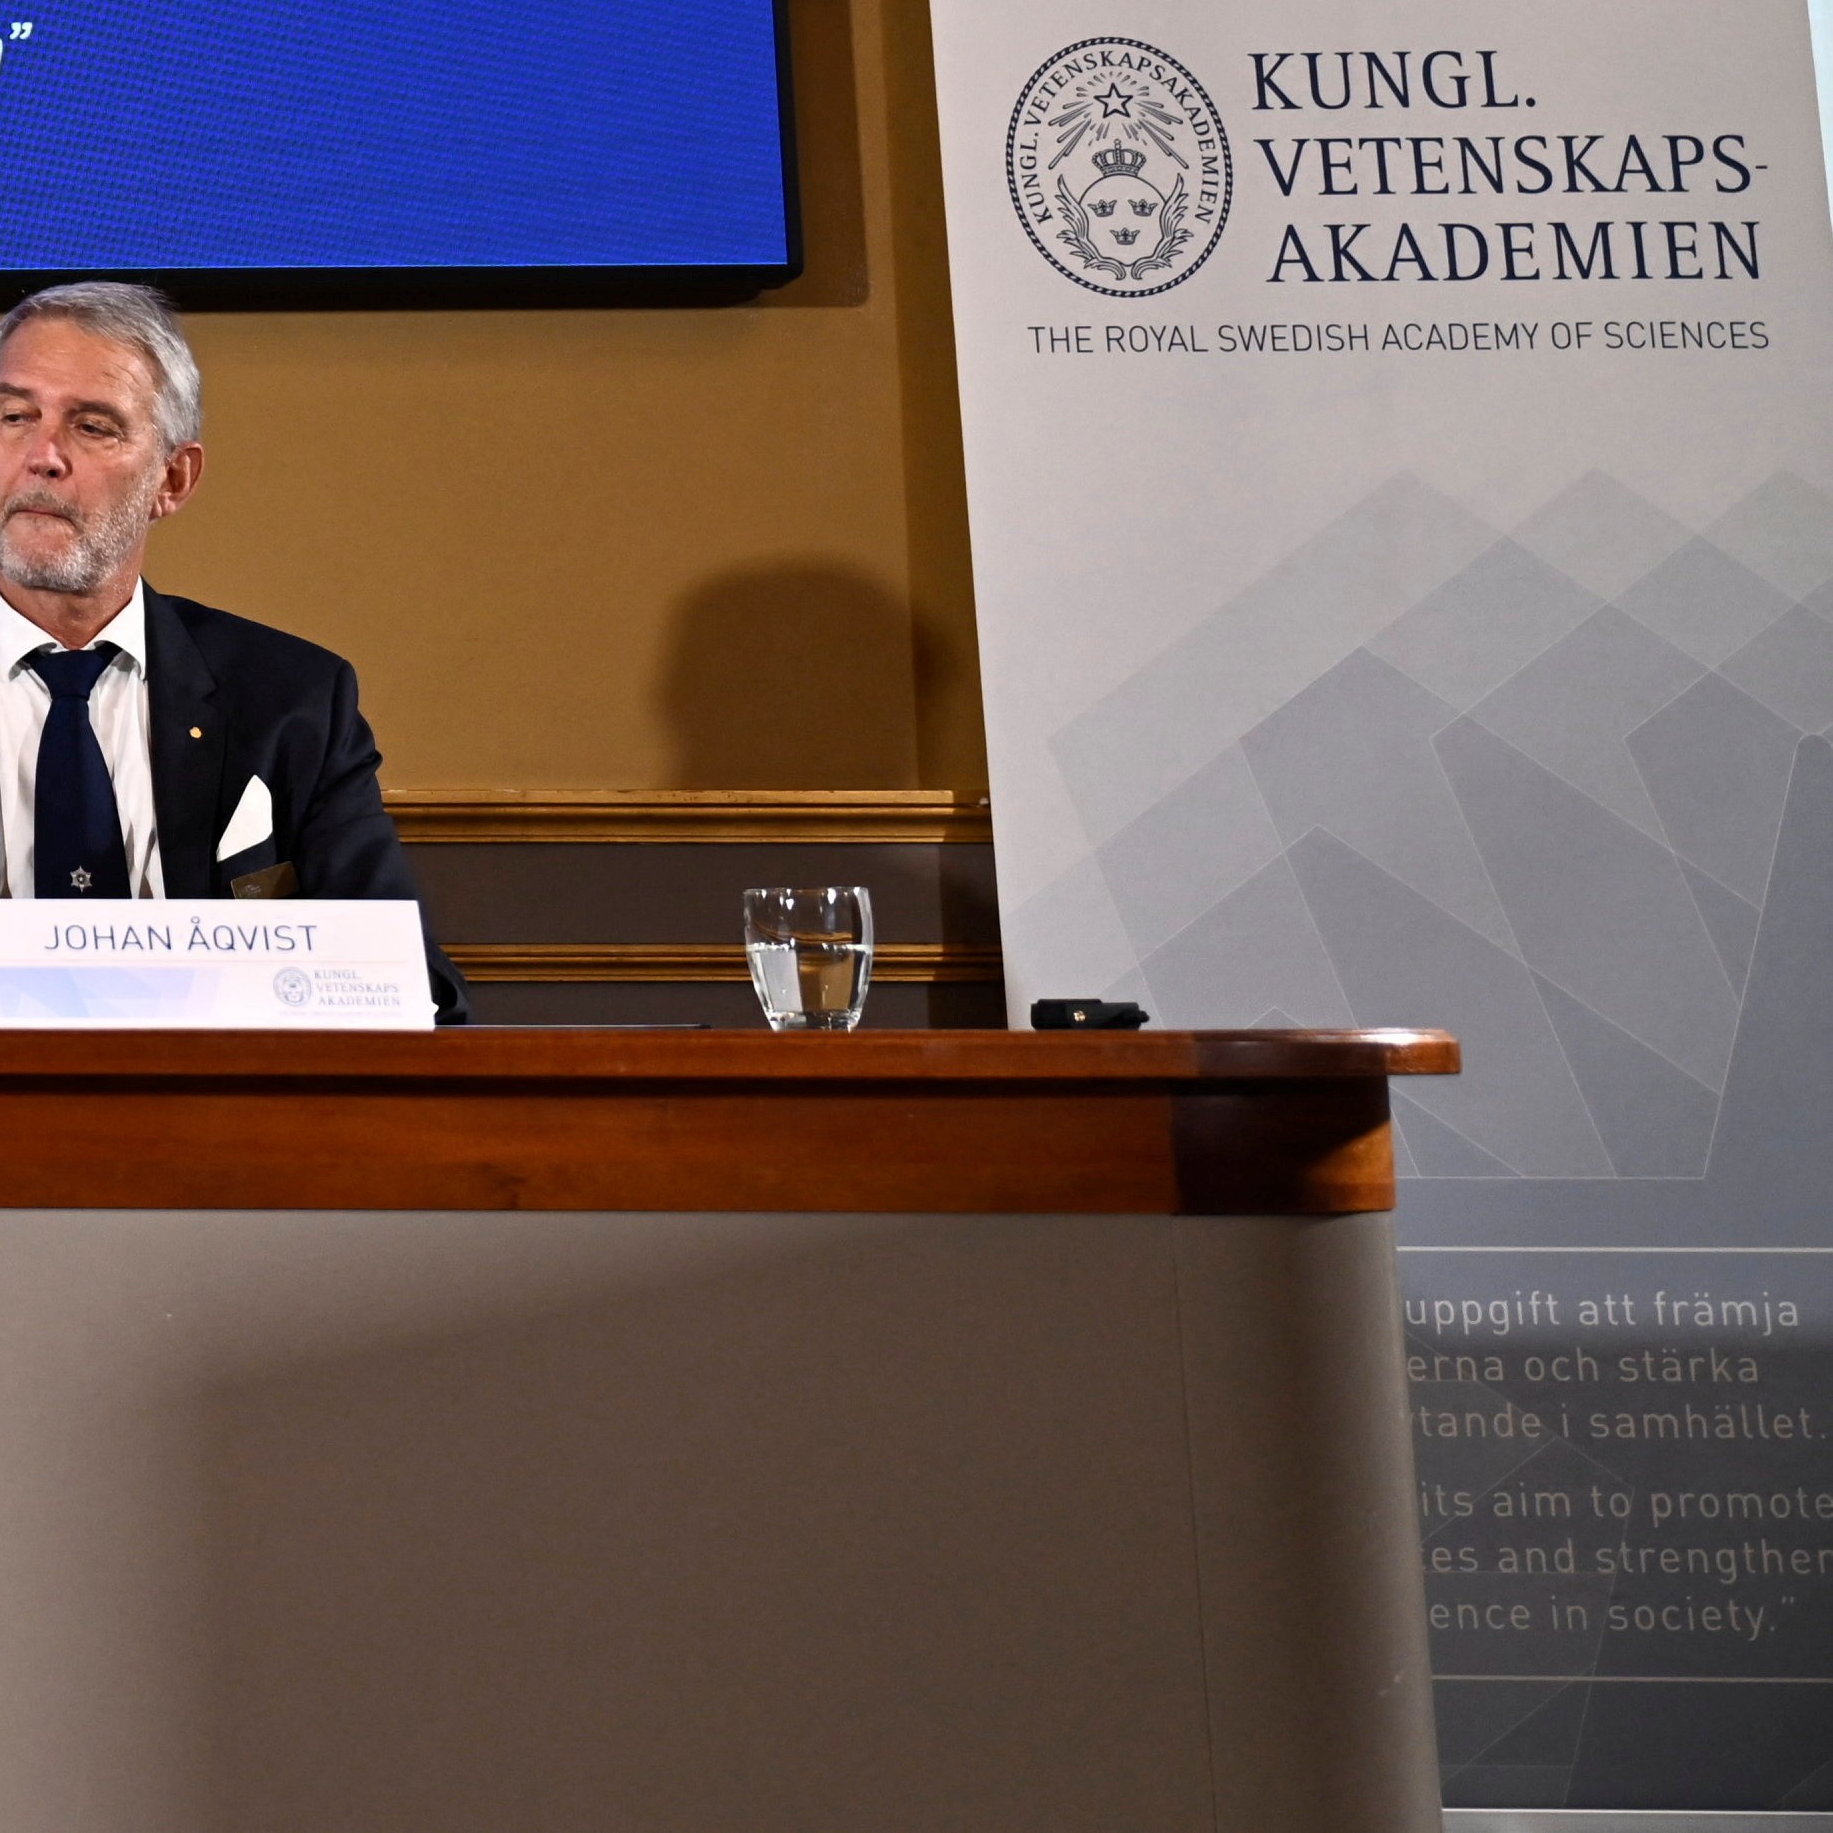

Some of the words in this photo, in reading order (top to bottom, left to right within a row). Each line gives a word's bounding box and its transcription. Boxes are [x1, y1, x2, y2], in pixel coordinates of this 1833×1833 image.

[1247, 50, 1536, 110] KUNGL.
[1025, 50, 1219, 224] VETENSKAPSAKADEMIEN
[1020, 132, 1052, 225] KUNGL.
[1253, 134, 1768, 197] VETENSKAPS-
[1266, 221, 1760, 282] AKADEMIEN
[1027, 326, 1093, 353] THE
[1106, 325, 1209, 352] ROYAL
[1218, 324, 1369, 352] SWEDISH
[1382, 323, 1538, 350] ACADEMY
[1551, 322, 1592, 350] OF
[1604, 321, 1769, 349] SCIENCES
[45, 925, 171, 950] JOHAN
[188, 917, 316, 951] ÅQVIST
[318, 996, 401, 1006] AKADEMIEN
[1406, 1290, 1560, 1335] uppgift
[1579, 1294, 1636, 1326] att
[1653, 1290, 1799, 1336] främja
[1407, 1355, 1504, 1382] erna
[1524, 1347, 1599, 1382] och
[1618, 1346, 1761, 1384] stärka
[1411, 1403, 1541, 1439] tande
[1561, 1403, 1569, 1439] i
[1590, 1404, 1826, 1439] samhället.
[1421, 1482, 1474, 1517] its
[1493, 1482, 1571, 1518] aim
[1592, 1487, 1632, 1518] to
[1652, 1488, 1833, 1527] promote
[1421, 1547, 1478, 1573] es
[1498, 1539, 1575, 1573] and
[1430, 1603, 1530, 1629] ence
[1551, 1595, 1587, 1630] in
